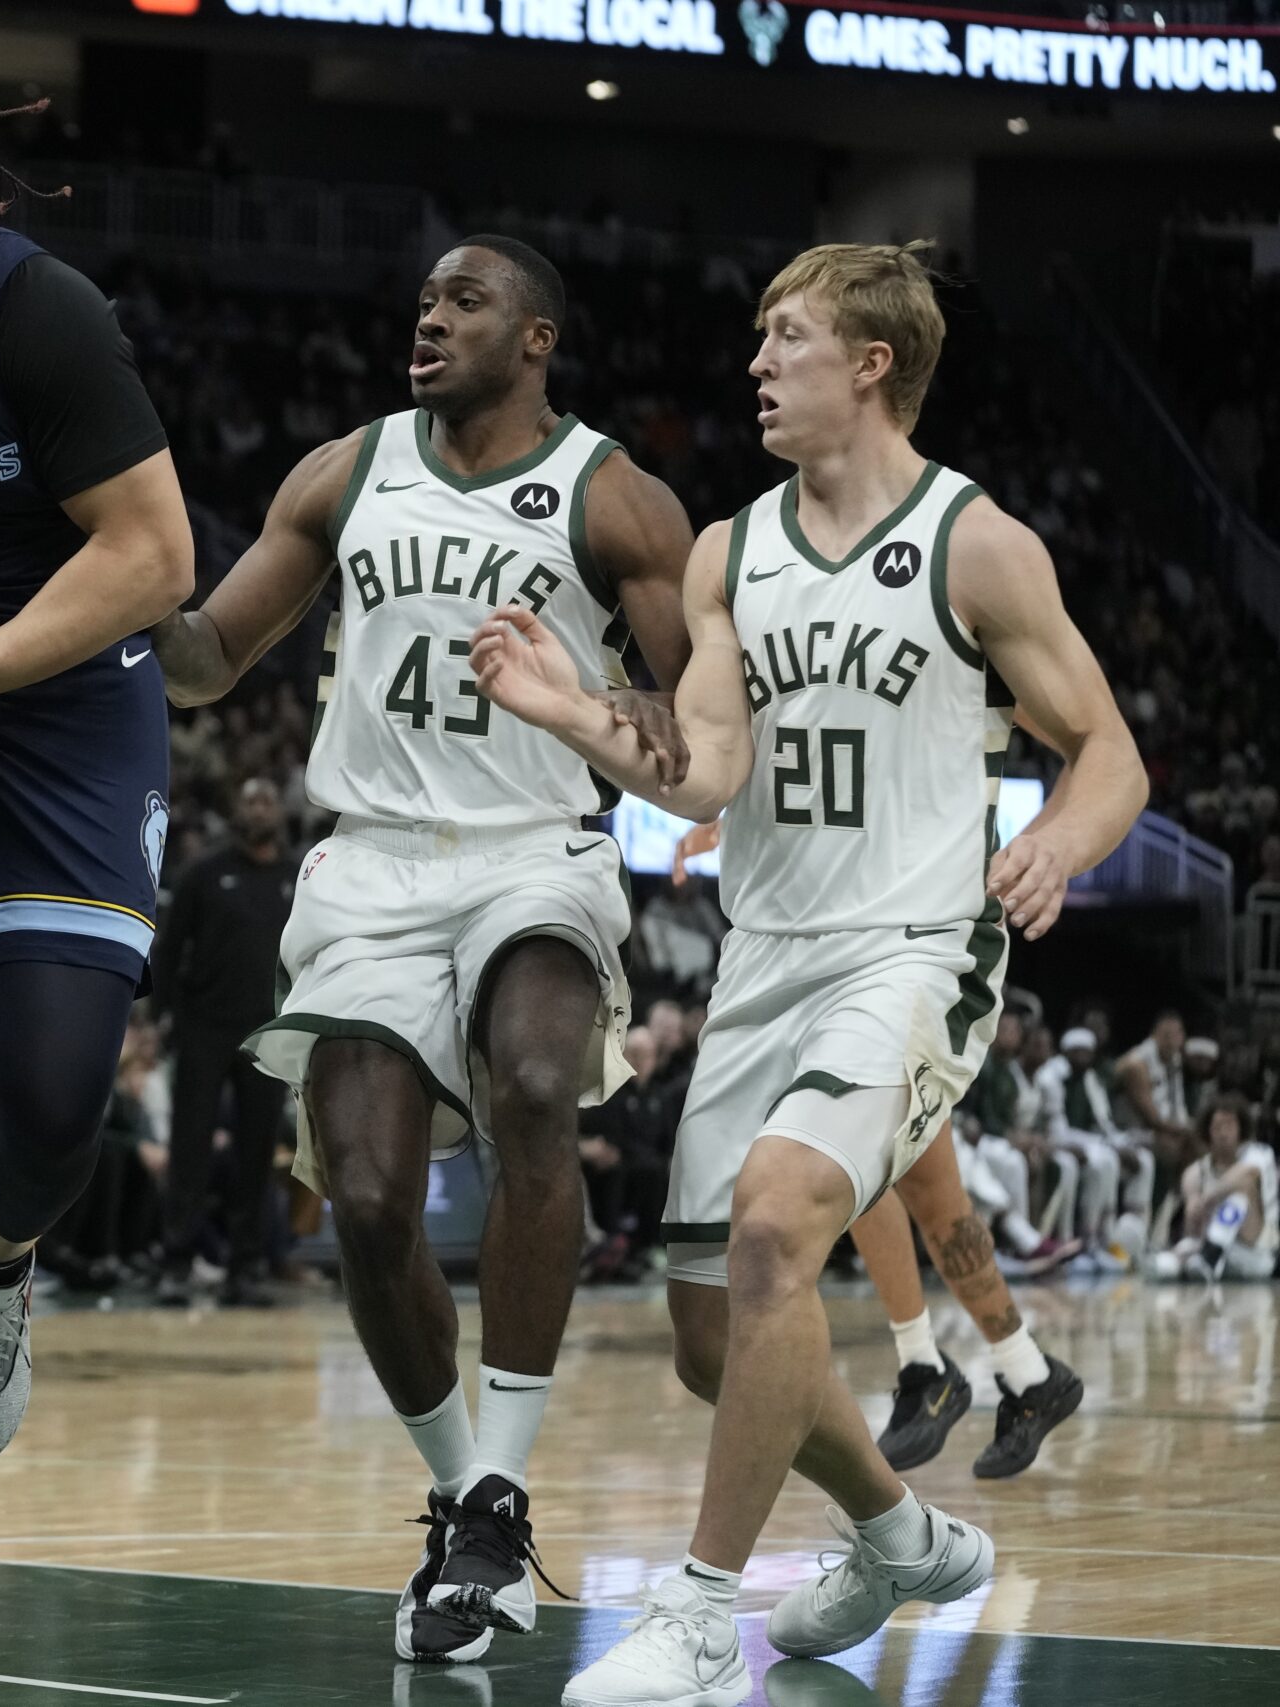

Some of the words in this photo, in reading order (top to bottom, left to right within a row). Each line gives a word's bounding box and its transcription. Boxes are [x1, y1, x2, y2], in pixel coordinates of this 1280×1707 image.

[500, 0, 585, 42] THE
[586, 0, 724, 55] LOCAL
[804, 9, 962, 76] GAMES.
[965, 23, 1128, 89] PRETTY
[1133, 36, 1277, 93] MUCH.
[347, 535, 563, 616] BUCKS
[385, 635, 491, 737] 43
[742, 621, 931, 715] BUCKS
[774, 726, 866, 829] 20
